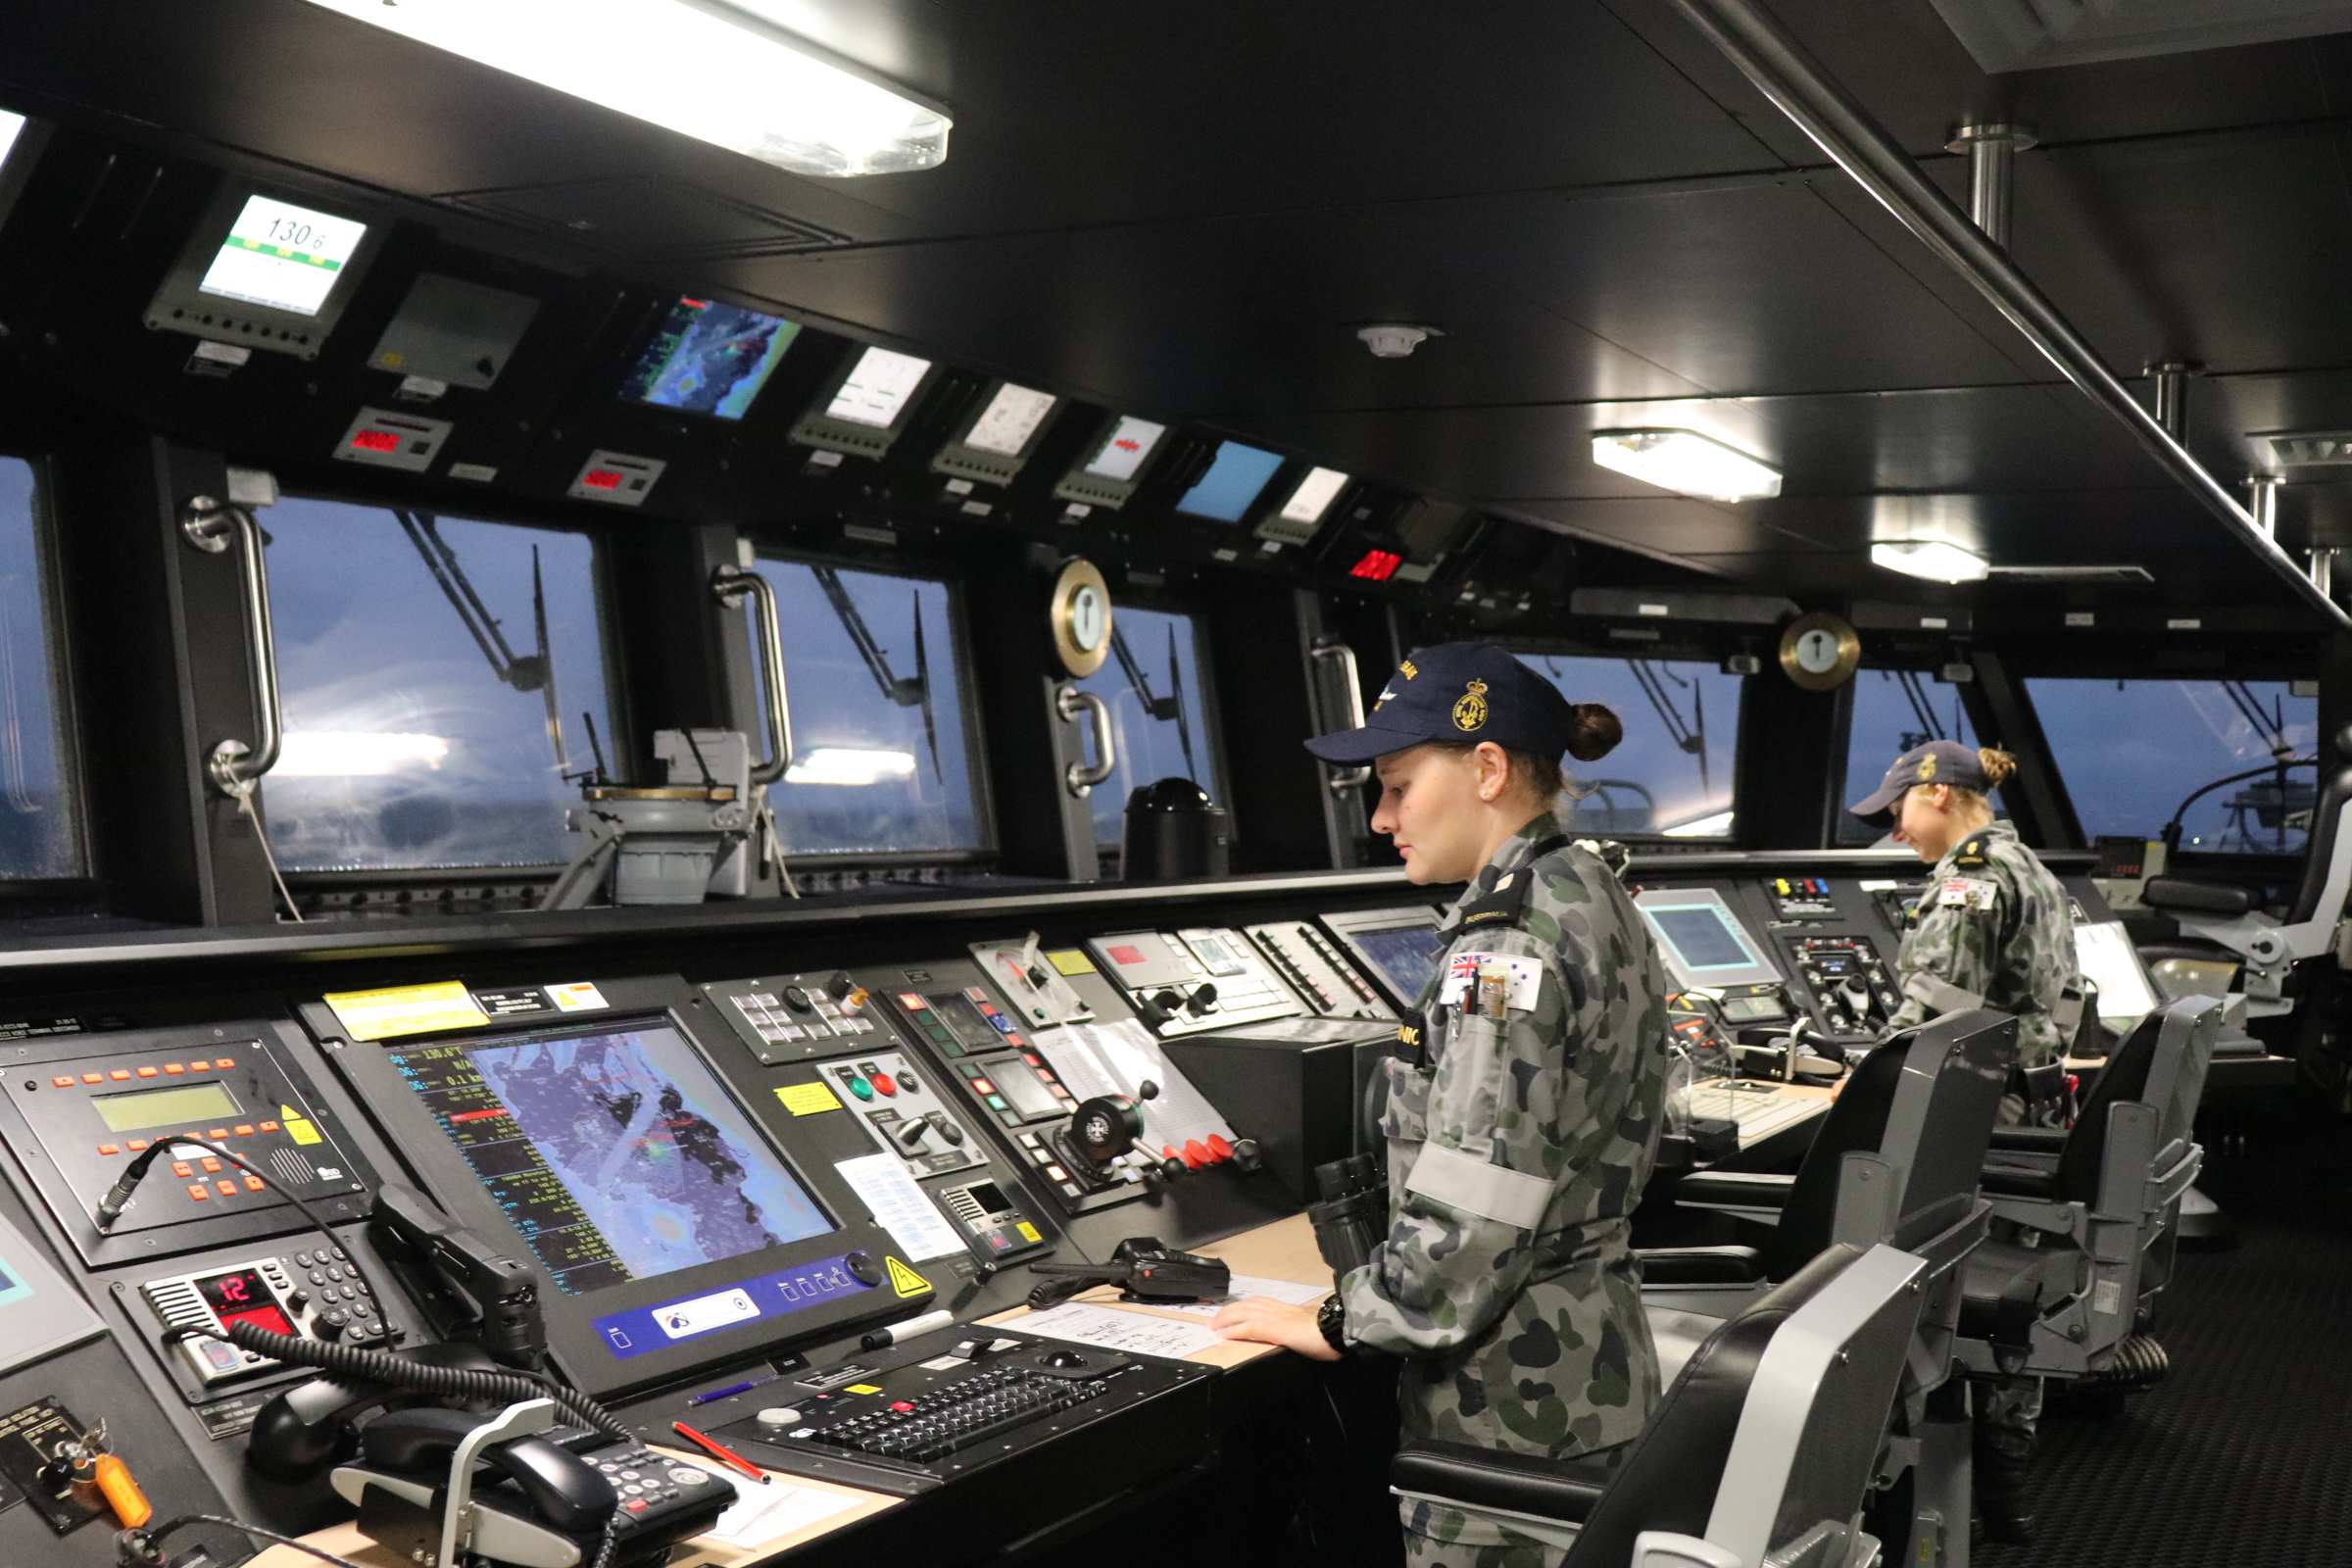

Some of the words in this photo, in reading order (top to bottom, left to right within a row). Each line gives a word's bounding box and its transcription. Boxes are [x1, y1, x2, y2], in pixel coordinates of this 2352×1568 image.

[268, 218, 312, 246] 130
[447, 1074, 468, 1086] 0.1
[219, 1275, 251, 1301] 12
